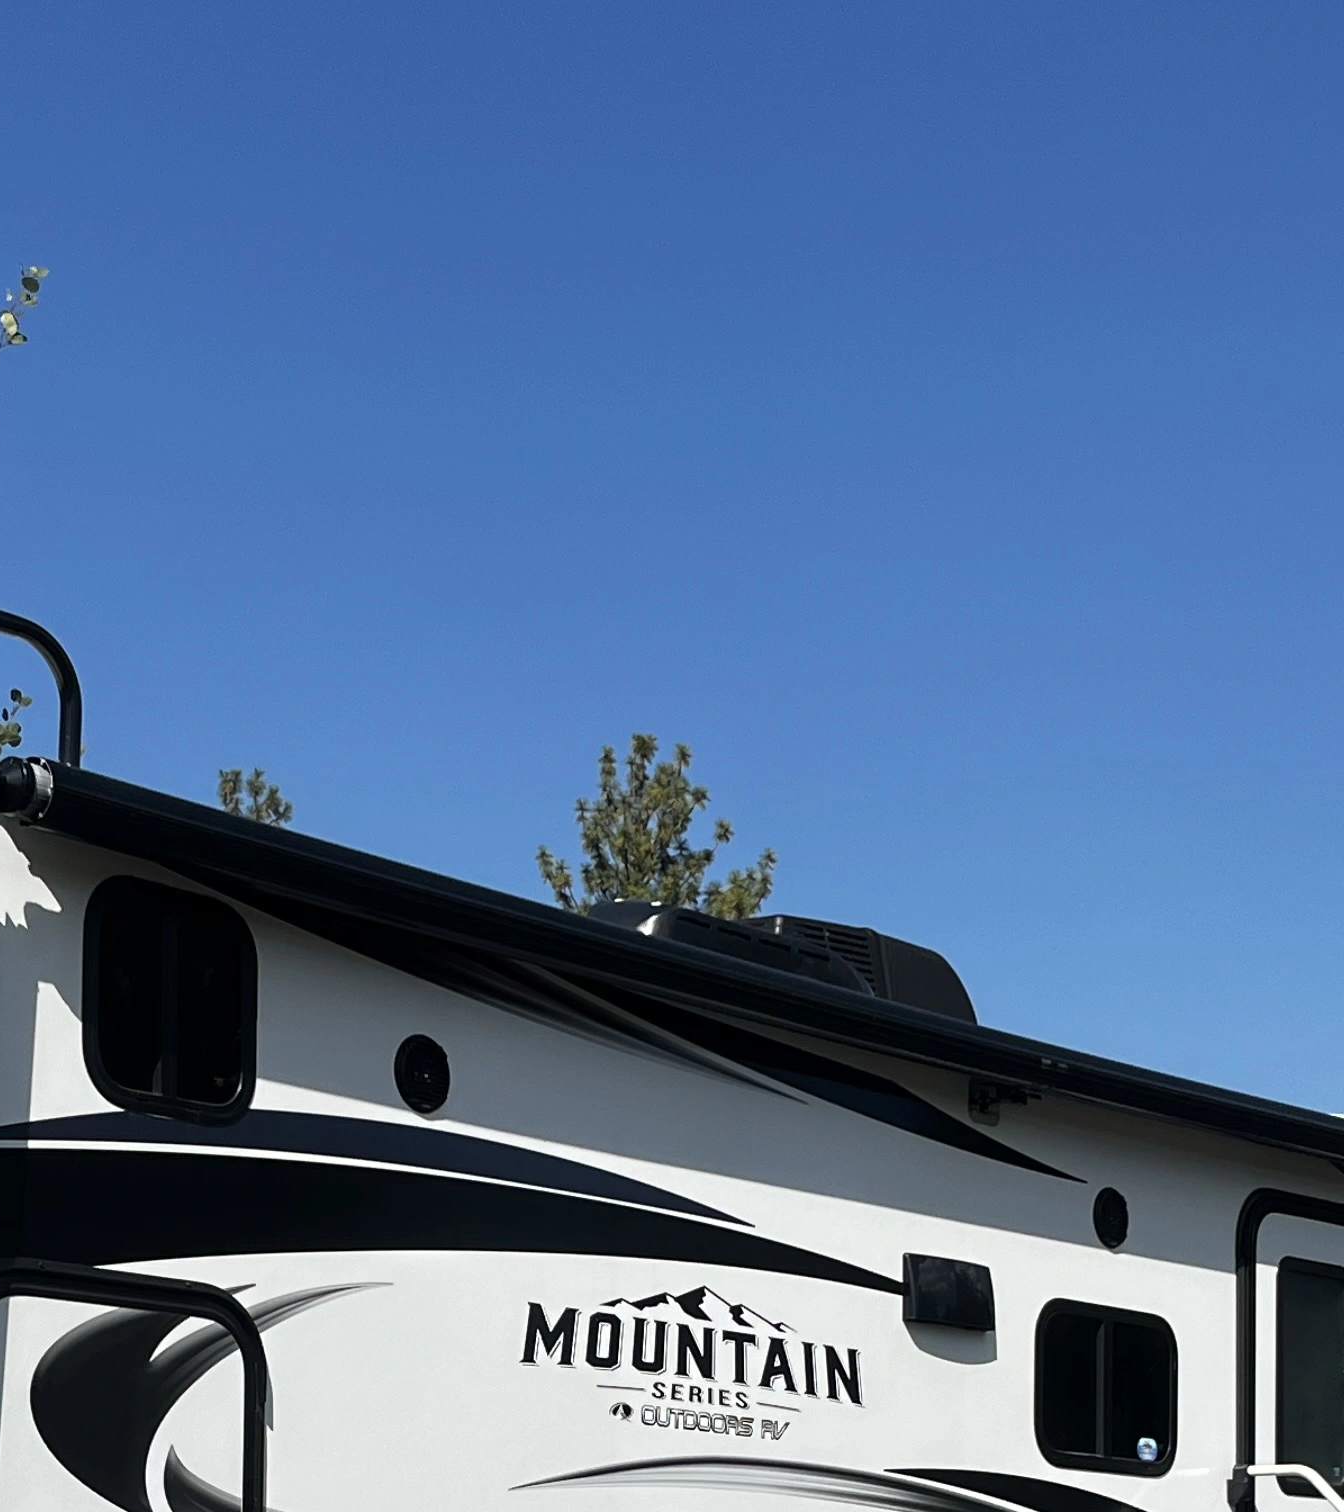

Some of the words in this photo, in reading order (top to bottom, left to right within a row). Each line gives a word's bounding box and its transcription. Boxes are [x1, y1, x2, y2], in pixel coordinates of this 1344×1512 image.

[519, 1301, 866, 1408] MOUNTAIN
[651, 1381, 750, 1410] SERIES
[640, 1403, 754, 1438] OUTDOORS
[760, 1419, 791, 1441] RV
